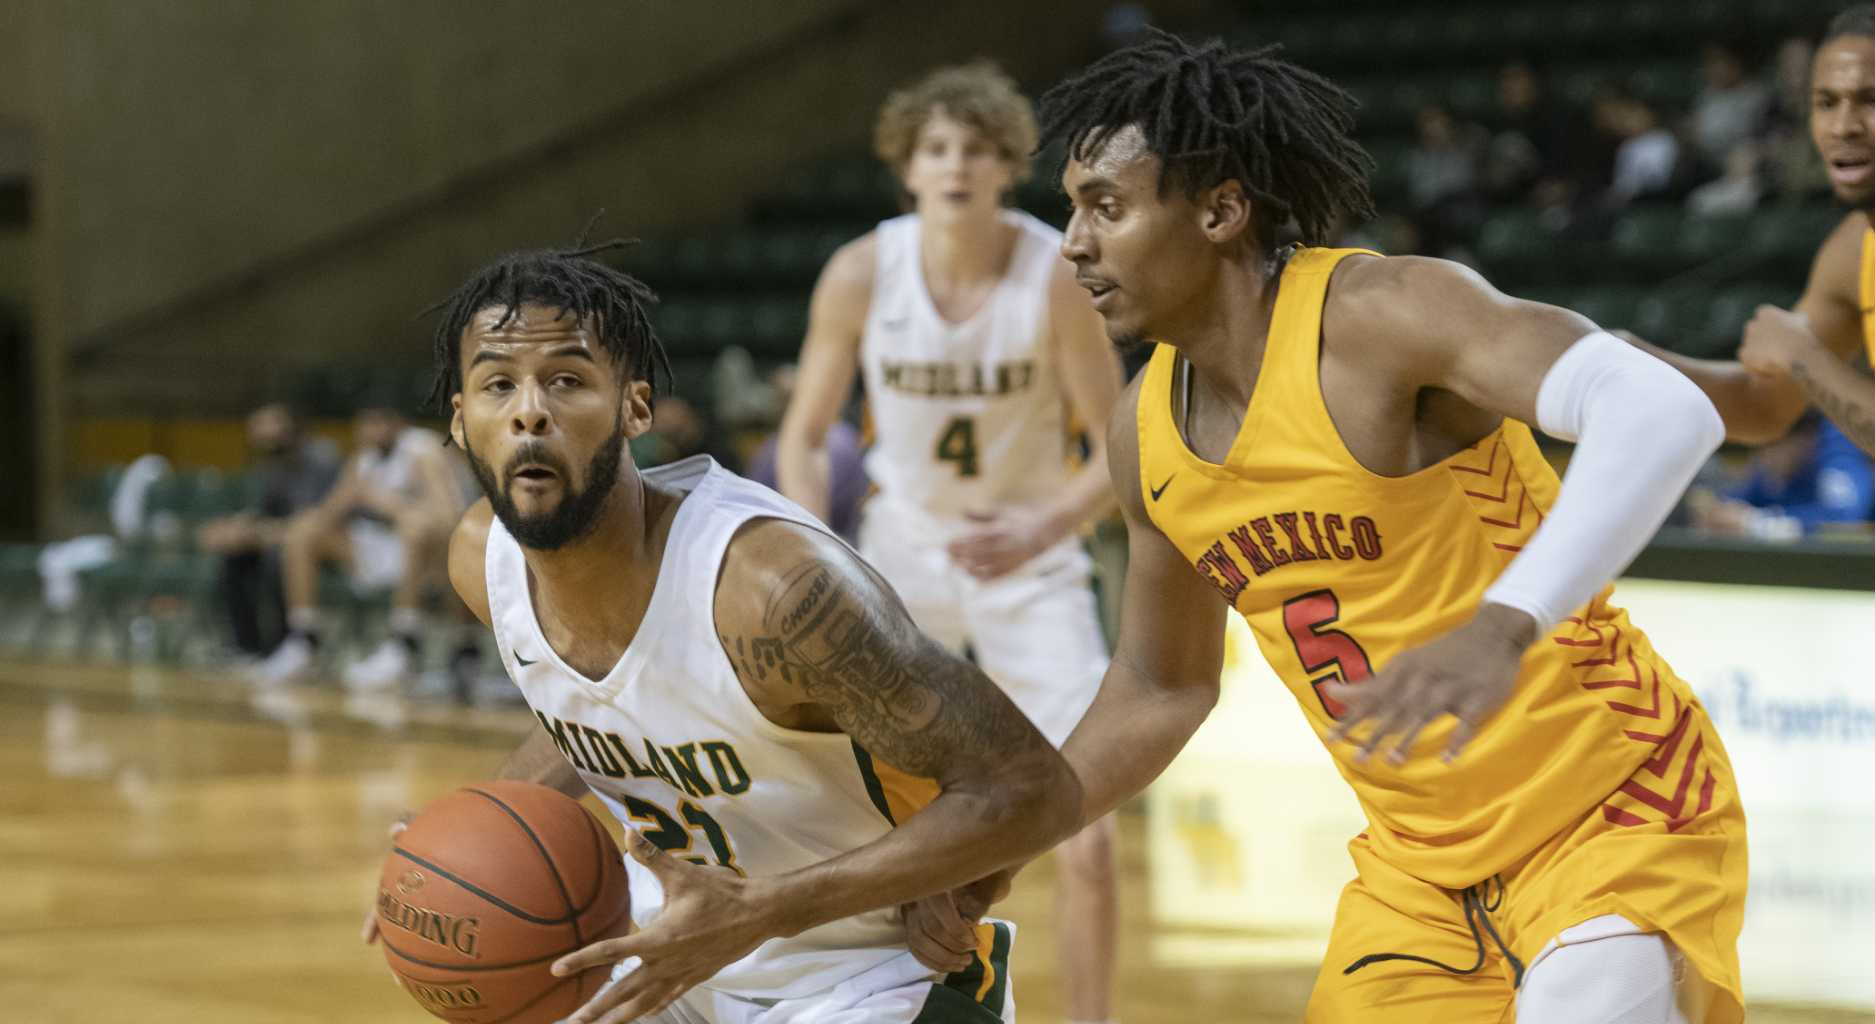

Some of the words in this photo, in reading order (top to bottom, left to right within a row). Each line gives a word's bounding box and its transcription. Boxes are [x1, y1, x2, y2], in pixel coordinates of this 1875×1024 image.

[935, 414, 981, 479] 4
[1196, 540, 1250, 609] EW
[1227, 511, 1383, 577] MEXICO
[1282, 587, 1376, 724] 5
[535, 708, 753, 798] MIDLAND
